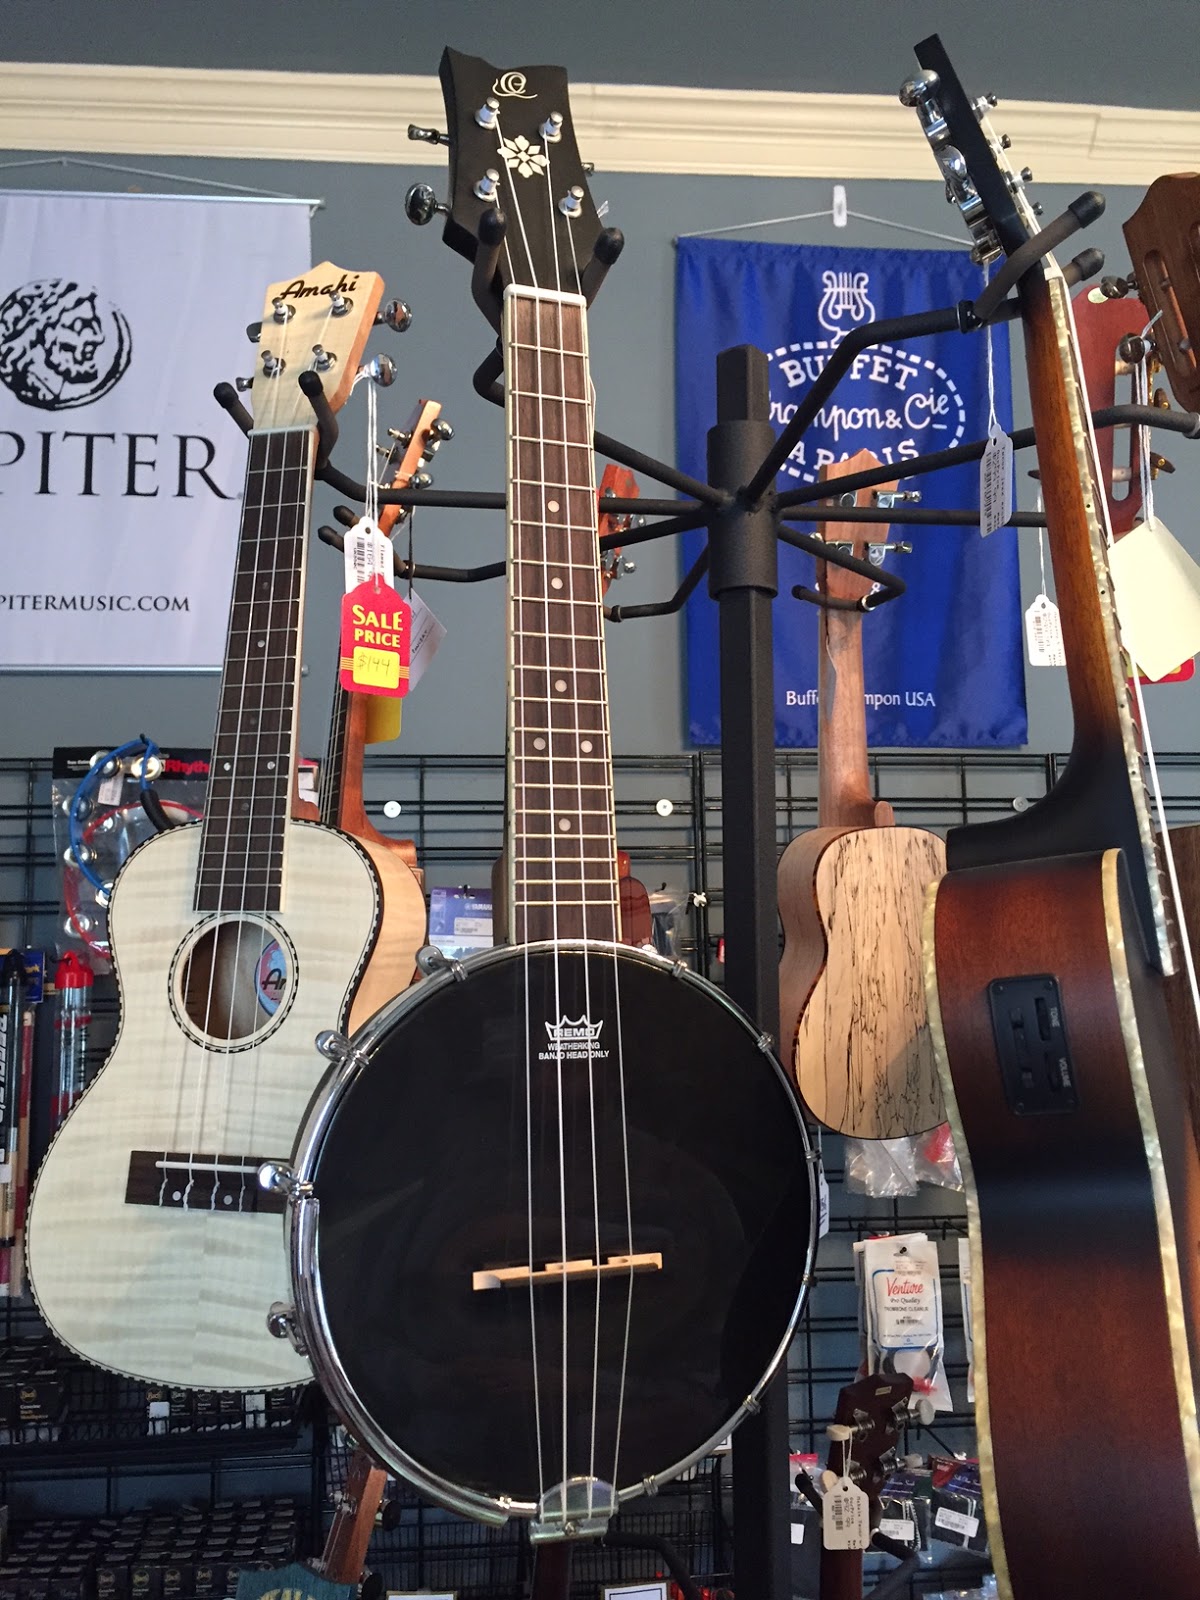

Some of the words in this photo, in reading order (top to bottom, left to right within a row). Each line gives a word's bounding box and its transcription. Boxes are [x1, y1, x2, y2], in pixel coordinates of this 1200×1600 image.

[279, 273, 361, 300] Amahi
[778, 353, 919, 391] BUFET
[352, 604, 404, 631] SALE
[354, 628, 401, 649] PRICE
[356, 652, 391, 676] $144
[786, 689, 819, 706] Buff
[864, 693, 901, 711] mpon
[905, 691, 936, 707] USA
[164, 759, 210, 776] Rhyth
[553, 1027, 596, 1037] REMO
[538, 1051, 565, 1060] BANJO
[566, 1051, 588, 1059] HEAD
[590, 1050, 610, 1058] ONLY
[547, 1042, 600, 1051] WEATHERKING
[886, 1277, 924, 1297] Venture
